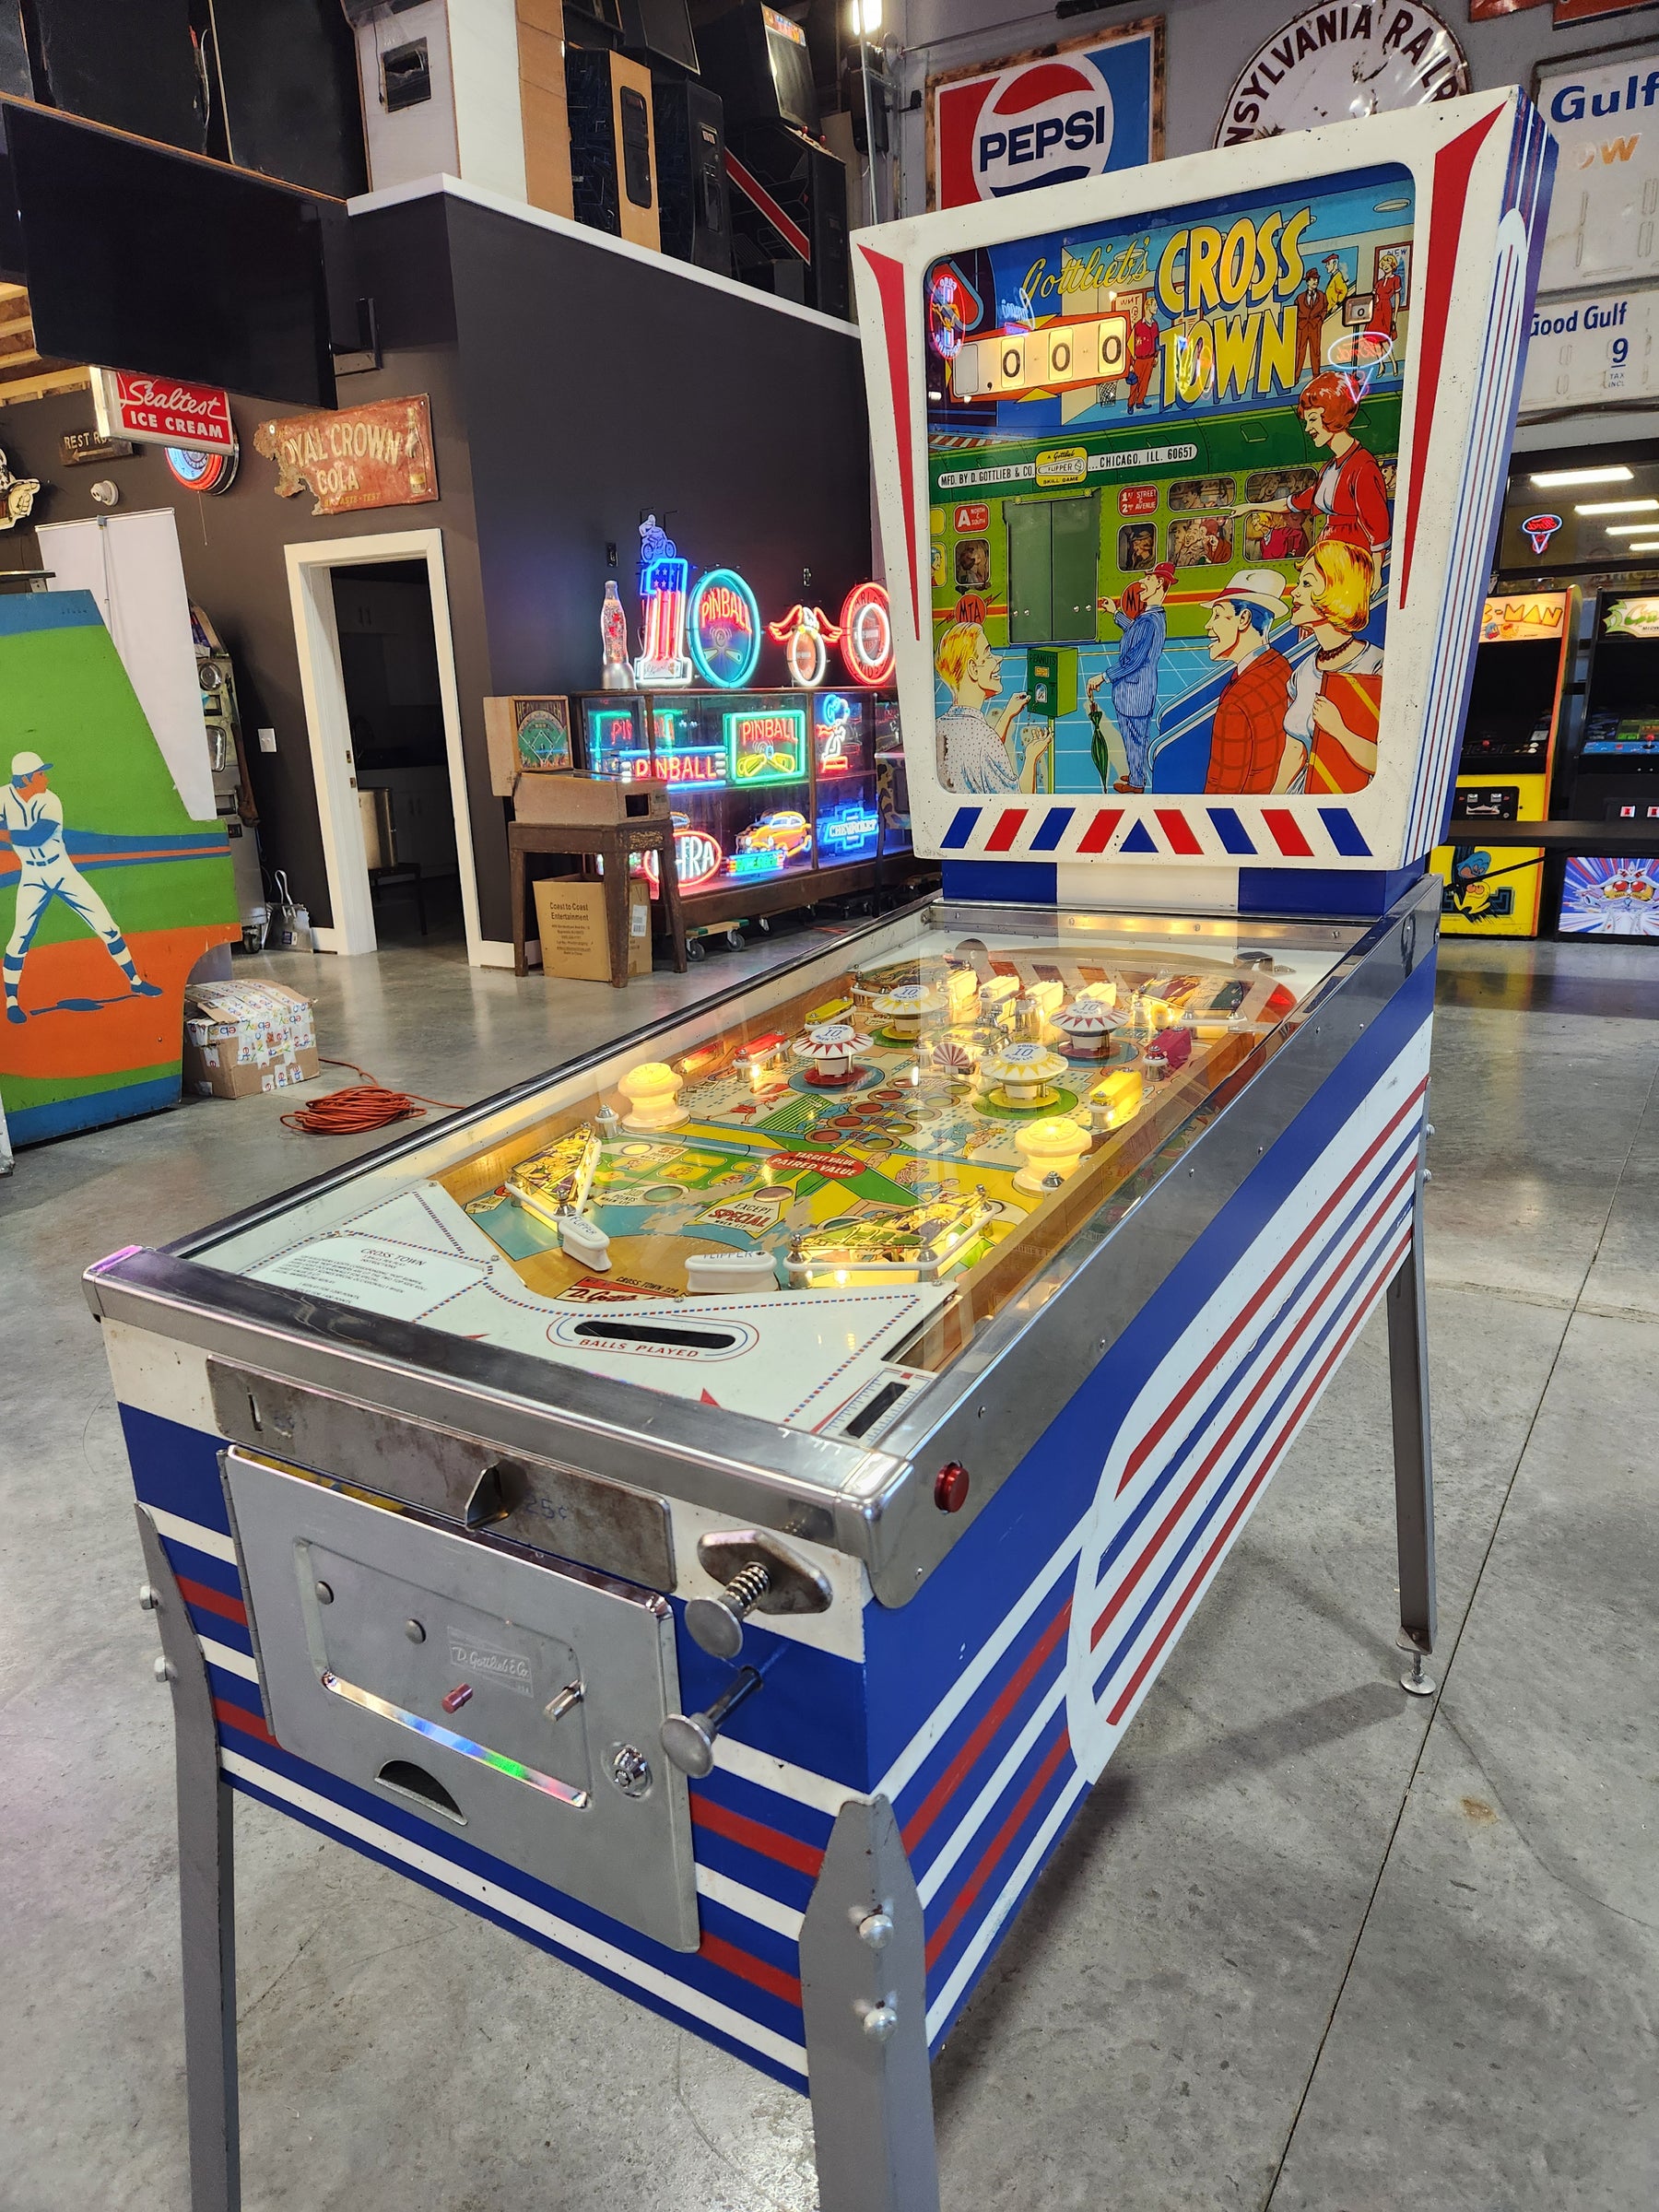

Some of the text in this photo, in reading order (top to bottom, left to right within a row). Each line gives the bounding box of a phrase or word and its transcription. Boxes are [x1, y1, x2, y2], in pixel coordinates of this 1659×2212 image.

[1550, 71, 1659, 124] Gulf
[979, 105, 1105, 173] PEPSI
[1386, 248, 1408, 257] NEW
[1022, 236, 1151, 305] Gottlieb's
[1157, 206, 1311, 319] CROSS
[1530, 301, 1628, 337] Good Gulf
[1002, 334, 1123, 379] 0 0 0
[1159, 305, 1300, 411] TOWN
[1612, 337, 1630, 363] 9
[121, 379, 223, 419] Sealtest
[130, 411, 224, 439] ICE CREAM
[64, 431, 89, 450] REST
[330, 422, 404, 468] CROWN
[941, 475, 957, 486] MFD.
[959, 473, 968, 484] BY
[971, 471, 977, 482] D.
[979, 468, 1012, 481] GOTTLIEB
[1015, 466, 1019, 477] &
[1023, 465, 1035, 477] CO.
[1146, 448, 1163, 463] ILL.
[1167, 446, 1193, 461] 60651
[1048, 463, 1073, 472] FLIPPER
[316, 465, 360, 496] COLA
[1136, 489, 1157, 499] STREET
[958, 509, 971, 528] A
[700, 586, 752, 635] PINBALL
[959, 603, 981, 624] MTA
[1030, 653, 1056, 665] PEANUTS
[742, 718, 799, 745] PINBALL
[571, 902, 588, 911] Coast
[551, 912, 590, 921] Entertainment
[824, 1029, 842, 1037] 10
[1013, 1048, 1034, 1057] 10
[865, 1116, 893, 1126] 100
[846, 1132, 870, 1140] 50
[657, 1146, 685, 1155] 50
[794, 1152, 828, 1163] TARGET
[829, 1156, 857, 1166] VALUE
[771, 1158, 818, 1170] PAIRED
[818, 1165, 857, 1176] VALUE
[708, 1208, 771, 1228] SPECIAL
[736, 1203, 774, 1215] EXCEPT
[570, 1216, 597, 1235] FLIPPER
[360, 1248, 427, 1266] CROSS TOWN
[616, 1276, 642, 1286] CROSS
[641, 1282, 664, 1291] TOWN
[579, 1338, 699, 1358] BALLS PLAYED
[452, 1646, 468, 1663] D.
[470, 1651, 508, 1672] Gottlieb
